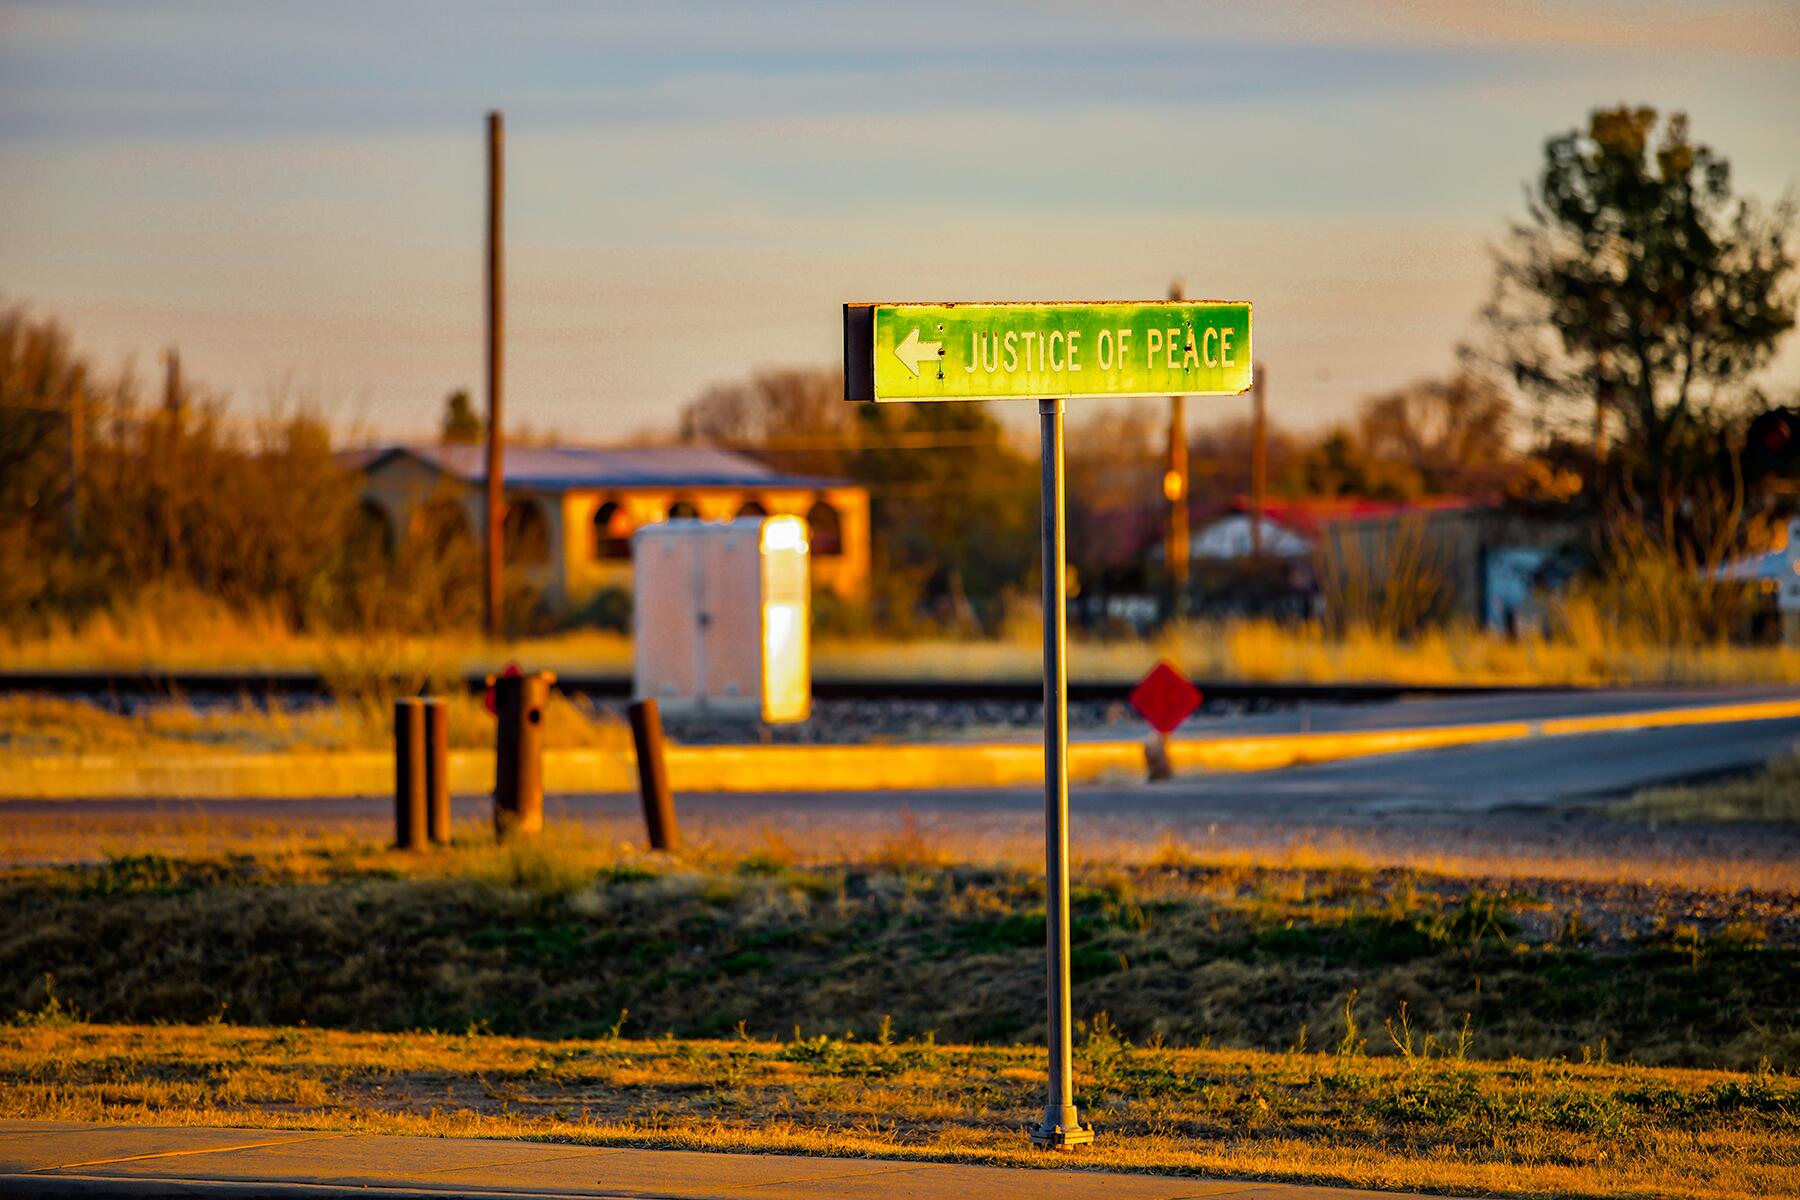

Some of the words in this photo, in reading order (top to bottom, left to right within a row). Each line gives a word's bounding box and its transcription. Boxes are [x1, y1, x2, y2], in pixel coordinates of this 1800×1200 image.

[964, 330, 1081, 374] JUSTICE
[1097, 328, 1133, 371] OF
[1147, 326, 1236, 370] PEACE
